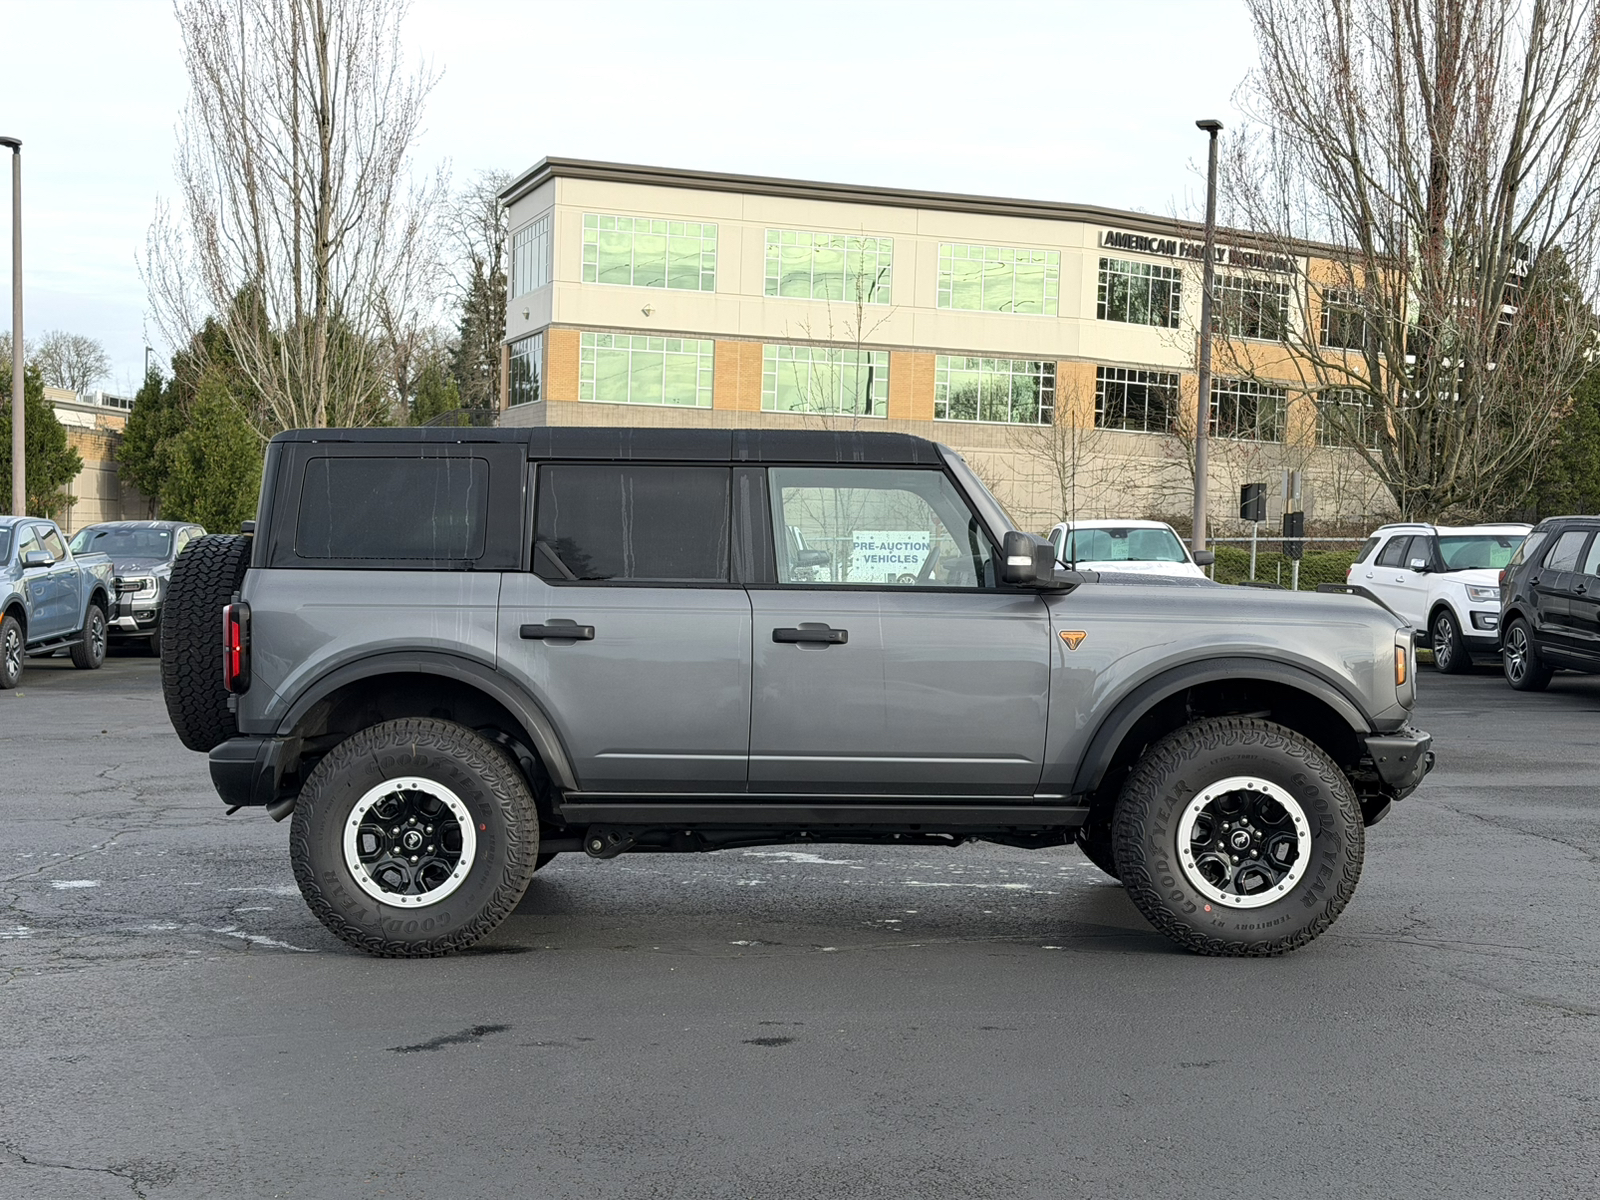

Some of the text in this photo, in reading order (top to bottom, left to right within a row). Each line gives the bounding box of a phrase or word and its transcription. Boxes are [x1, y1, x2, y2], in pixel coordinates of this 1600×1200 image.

[1104, 230, 1177, 255] AMERICAN
[1179, 241, 1227, 263] FAMLY
[853, 542, 930, 551] PRE-AUCTION
[863, 554, 919, 564] VEHICLES
[1148, 779, 1195, 915] GOODYEAR
[1290, 772, 1342, 909] GOODYEAR
[1234, 913, 1292, 931] TERRITORY
